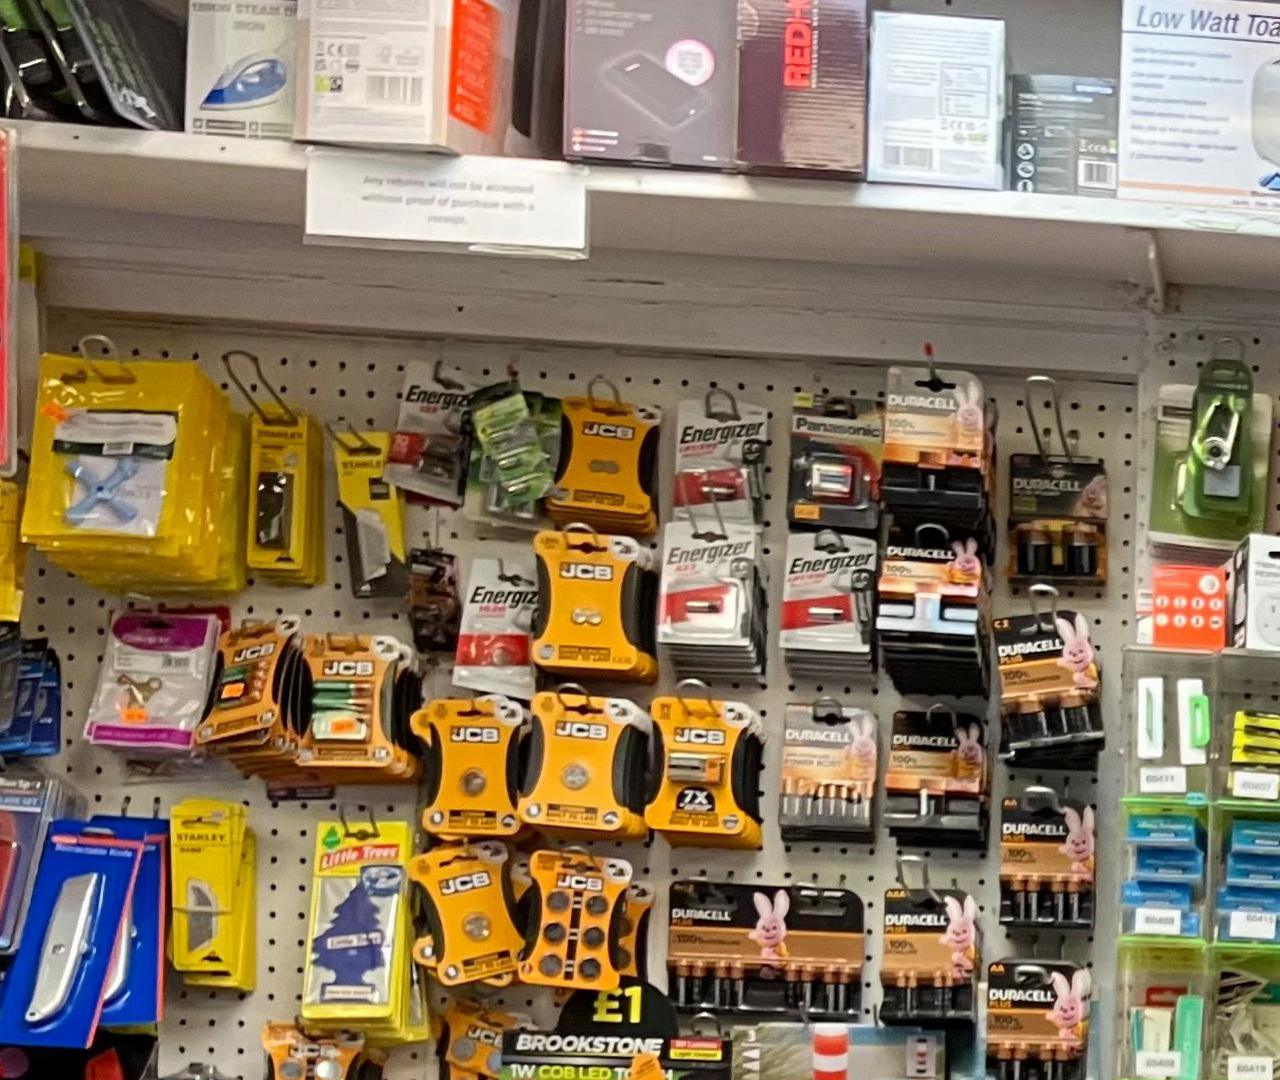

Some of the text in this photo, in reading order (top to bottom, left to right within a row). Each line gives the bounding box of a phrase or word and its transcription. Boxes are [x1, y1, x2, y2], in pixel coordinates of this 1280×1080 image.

[1136, 8, 1181, 30] Low
[1189, 11, 1240, 34] Watt
[405, 384, 478, 408] Energiz
[888, 394, 958, 410] DURACELL
[584, 422, 635, 439] JCB
[680, 420, 765, 444] Energizer
[796, 417, 882, 438] Panasonic
[1013, 478, 1084, 493] DURACELL
[667, 540, 752, 566] Energizer
[886, 547, 955, 560] DURACELL
[560, 562, 614, 580] JCB
[790, 552, 875, 574] Energizer
[470, 586, 539, 608] Energiz
[235, 643, 275, 663] JCB
[998, 639, 1064, 657] DURACELL
[325, 661, 374, 676] JCB
[451, 727, 500, 743] JCB
[556, 722, 608, 739] JCB
[675, 728, 725, 745] JCB
[786, 730, 850, 743] DURACELL
[893, 735, 957, 748] DURACELL
[683, 789, 708, 804] 7X
[1003, 823, 1066, 837] DURACELL
[321, 845, 398, 868] Little Trees
[441, 873, 491, 895] JCB
[557, 875, 604, 890] JCB
[671, 908, 731, 922] DURACELL
[885, 914, 947, 927] DURACELL
[988, 988, 1054, 1003] DURACELL
[593, 985, 642, 1024] £1
[516, 1033, 665, 1056] BROOKSTONE
[539, 1066, 575, 1080] COB
[580, 1066, 612, 1080] LED
